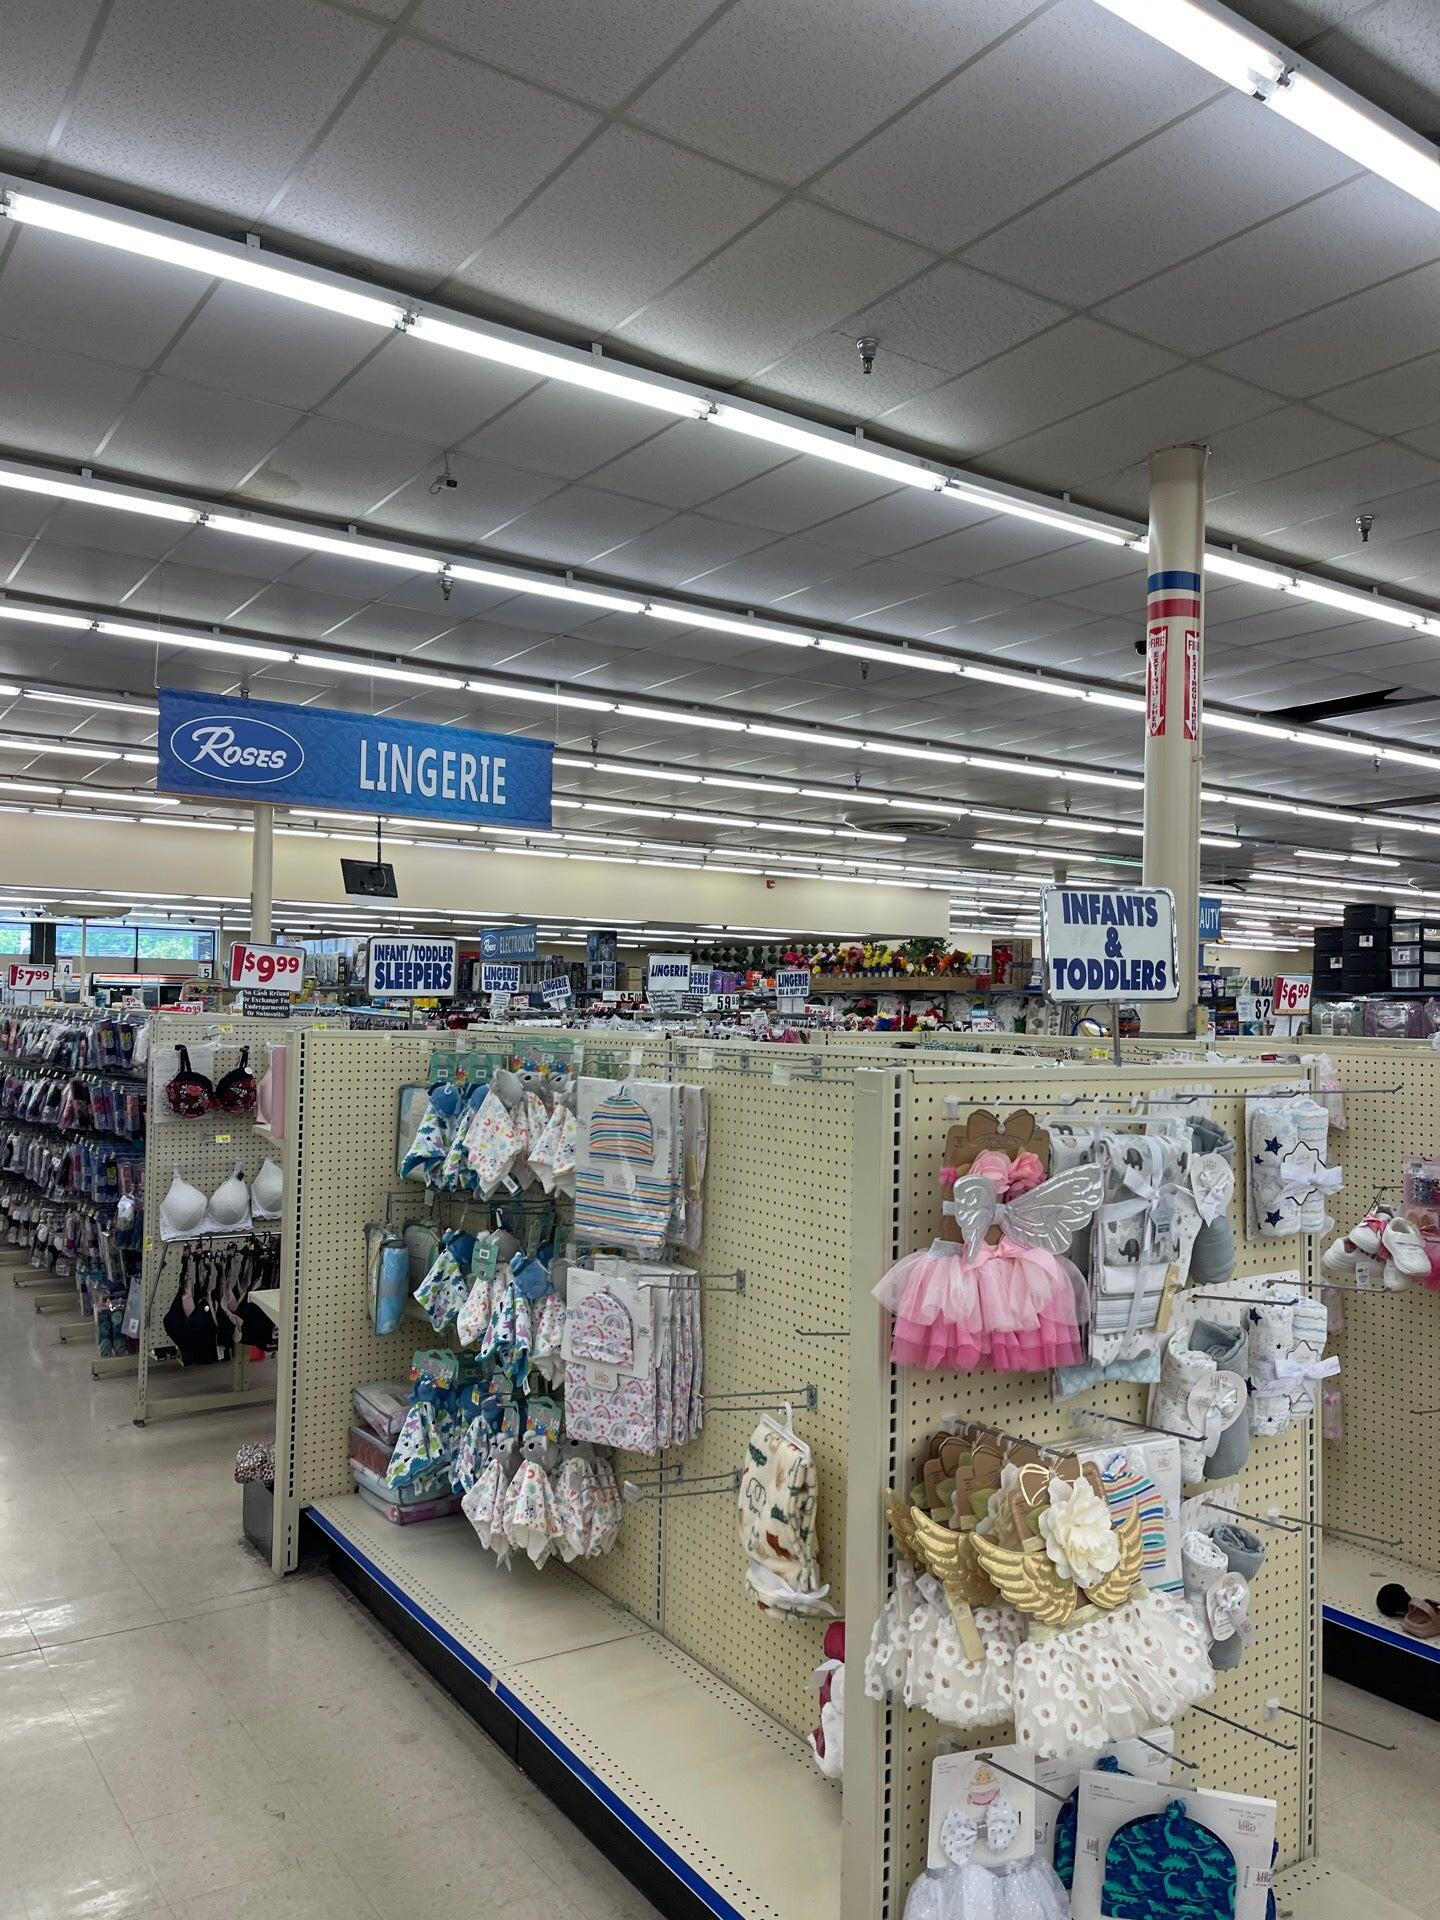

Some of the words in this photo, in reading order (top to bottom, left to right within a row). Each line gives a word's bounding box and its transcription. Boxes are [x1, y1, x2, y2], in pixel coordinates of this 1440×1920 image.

[359, 739, 507, 805] LINGERIE
[1061, 892, 1159, 928] INFANTS
[500, 934, 535, 954] ELECTRONICS
[1104, 926, 1124, 958] &
[63, 964, 70, 975] 4
[203, 968, 210, 978] 5
[374, 961, 452, 990] SLEEPERS
[483, 965, 519, 981] LINGERIE
[650, 964, 689, 977] LINGERIE
[1052, 957, 1167, 991] TODDLERS
[484, 981, 518, 991] BRAS
[541, 977, 568, 993] LINGERIE
[778, 973, 809, 988] LINGERIE
